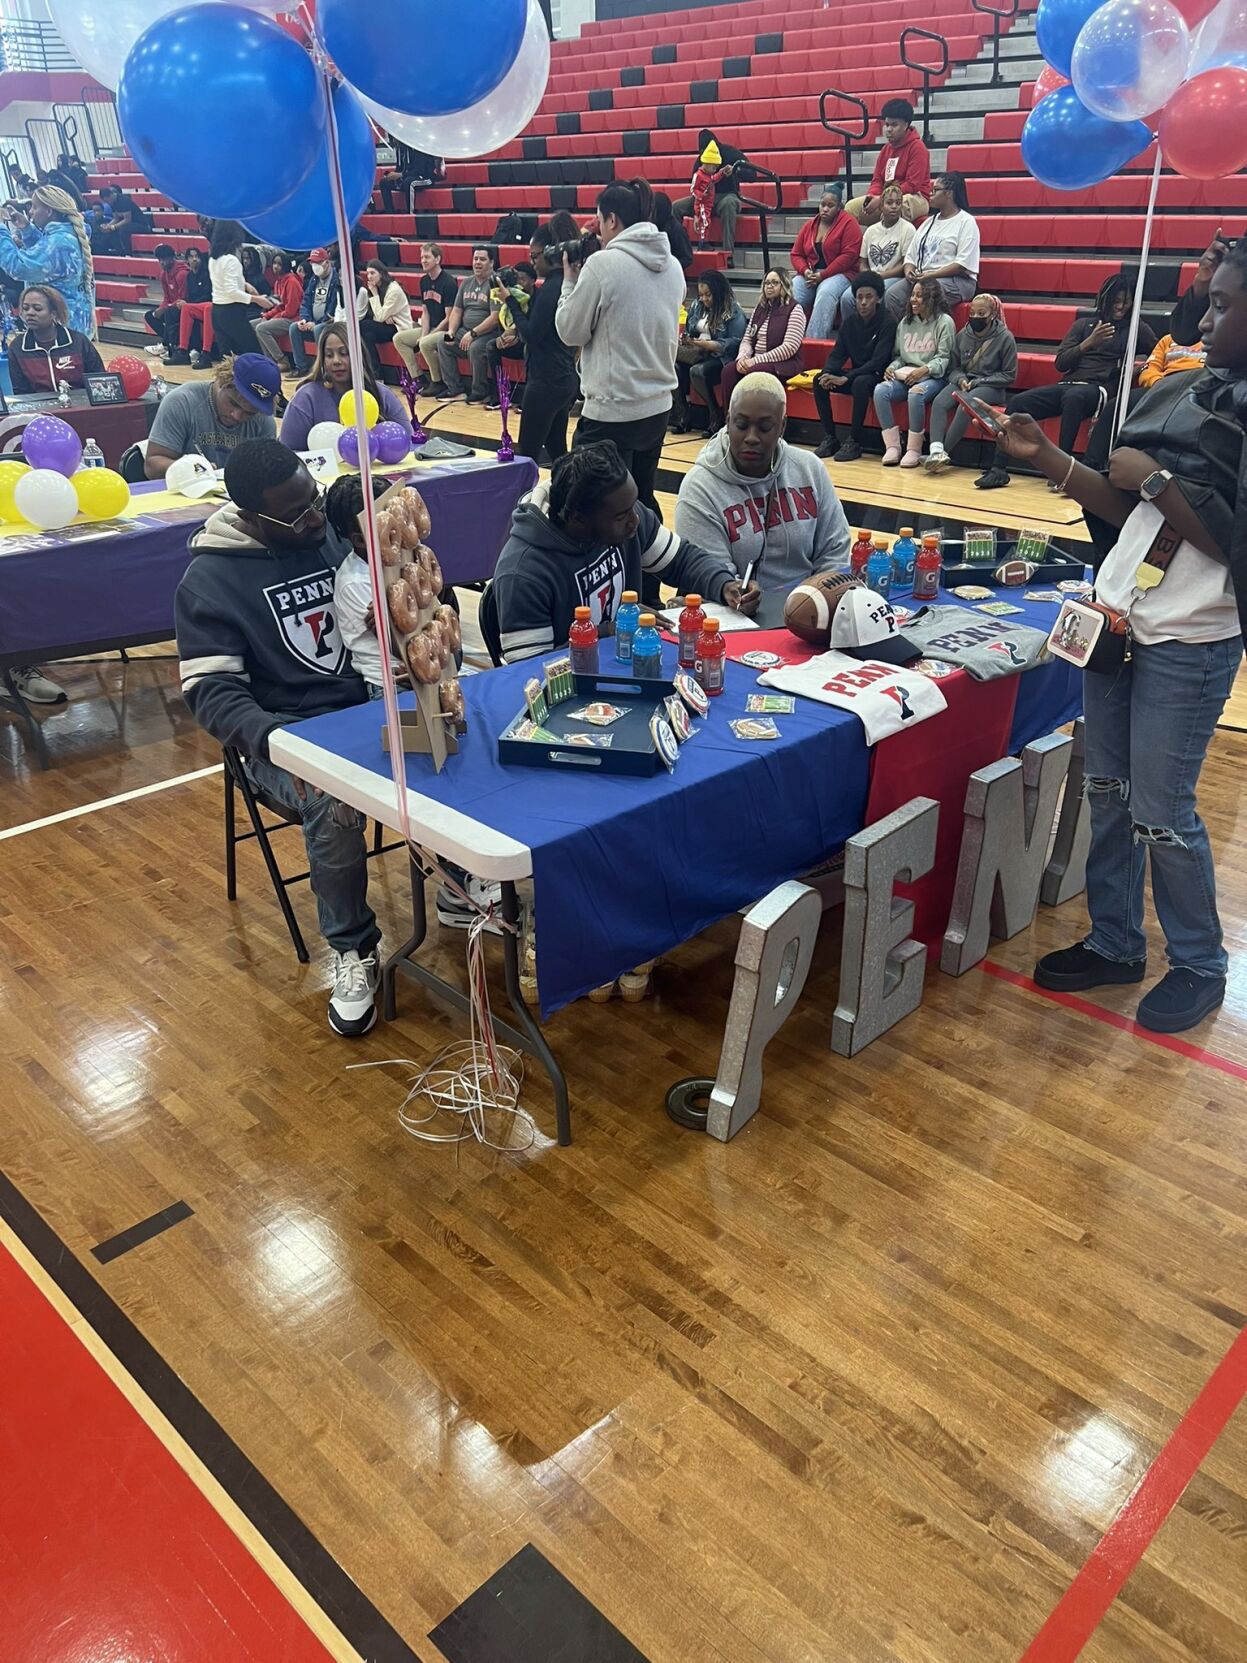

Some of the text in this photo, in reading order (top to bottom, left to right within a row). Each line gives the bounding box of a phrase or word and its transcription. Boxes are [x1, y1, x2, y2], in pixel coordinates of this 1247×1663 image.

[722, 486, 818, 543] PENN
[582, 552, 618, 591] PENN
[906, 561, 915, 572] G
[925, 572, 936, 583] G
[276, 577, 334, 610] PENN
[878, 576, 888, 586] G
[870, 604, 895, 623] PEN
[927, 621, 1022, 653] PENN
[694, 660, 703, 673] G
[822, 664, 900, 698] PENN
